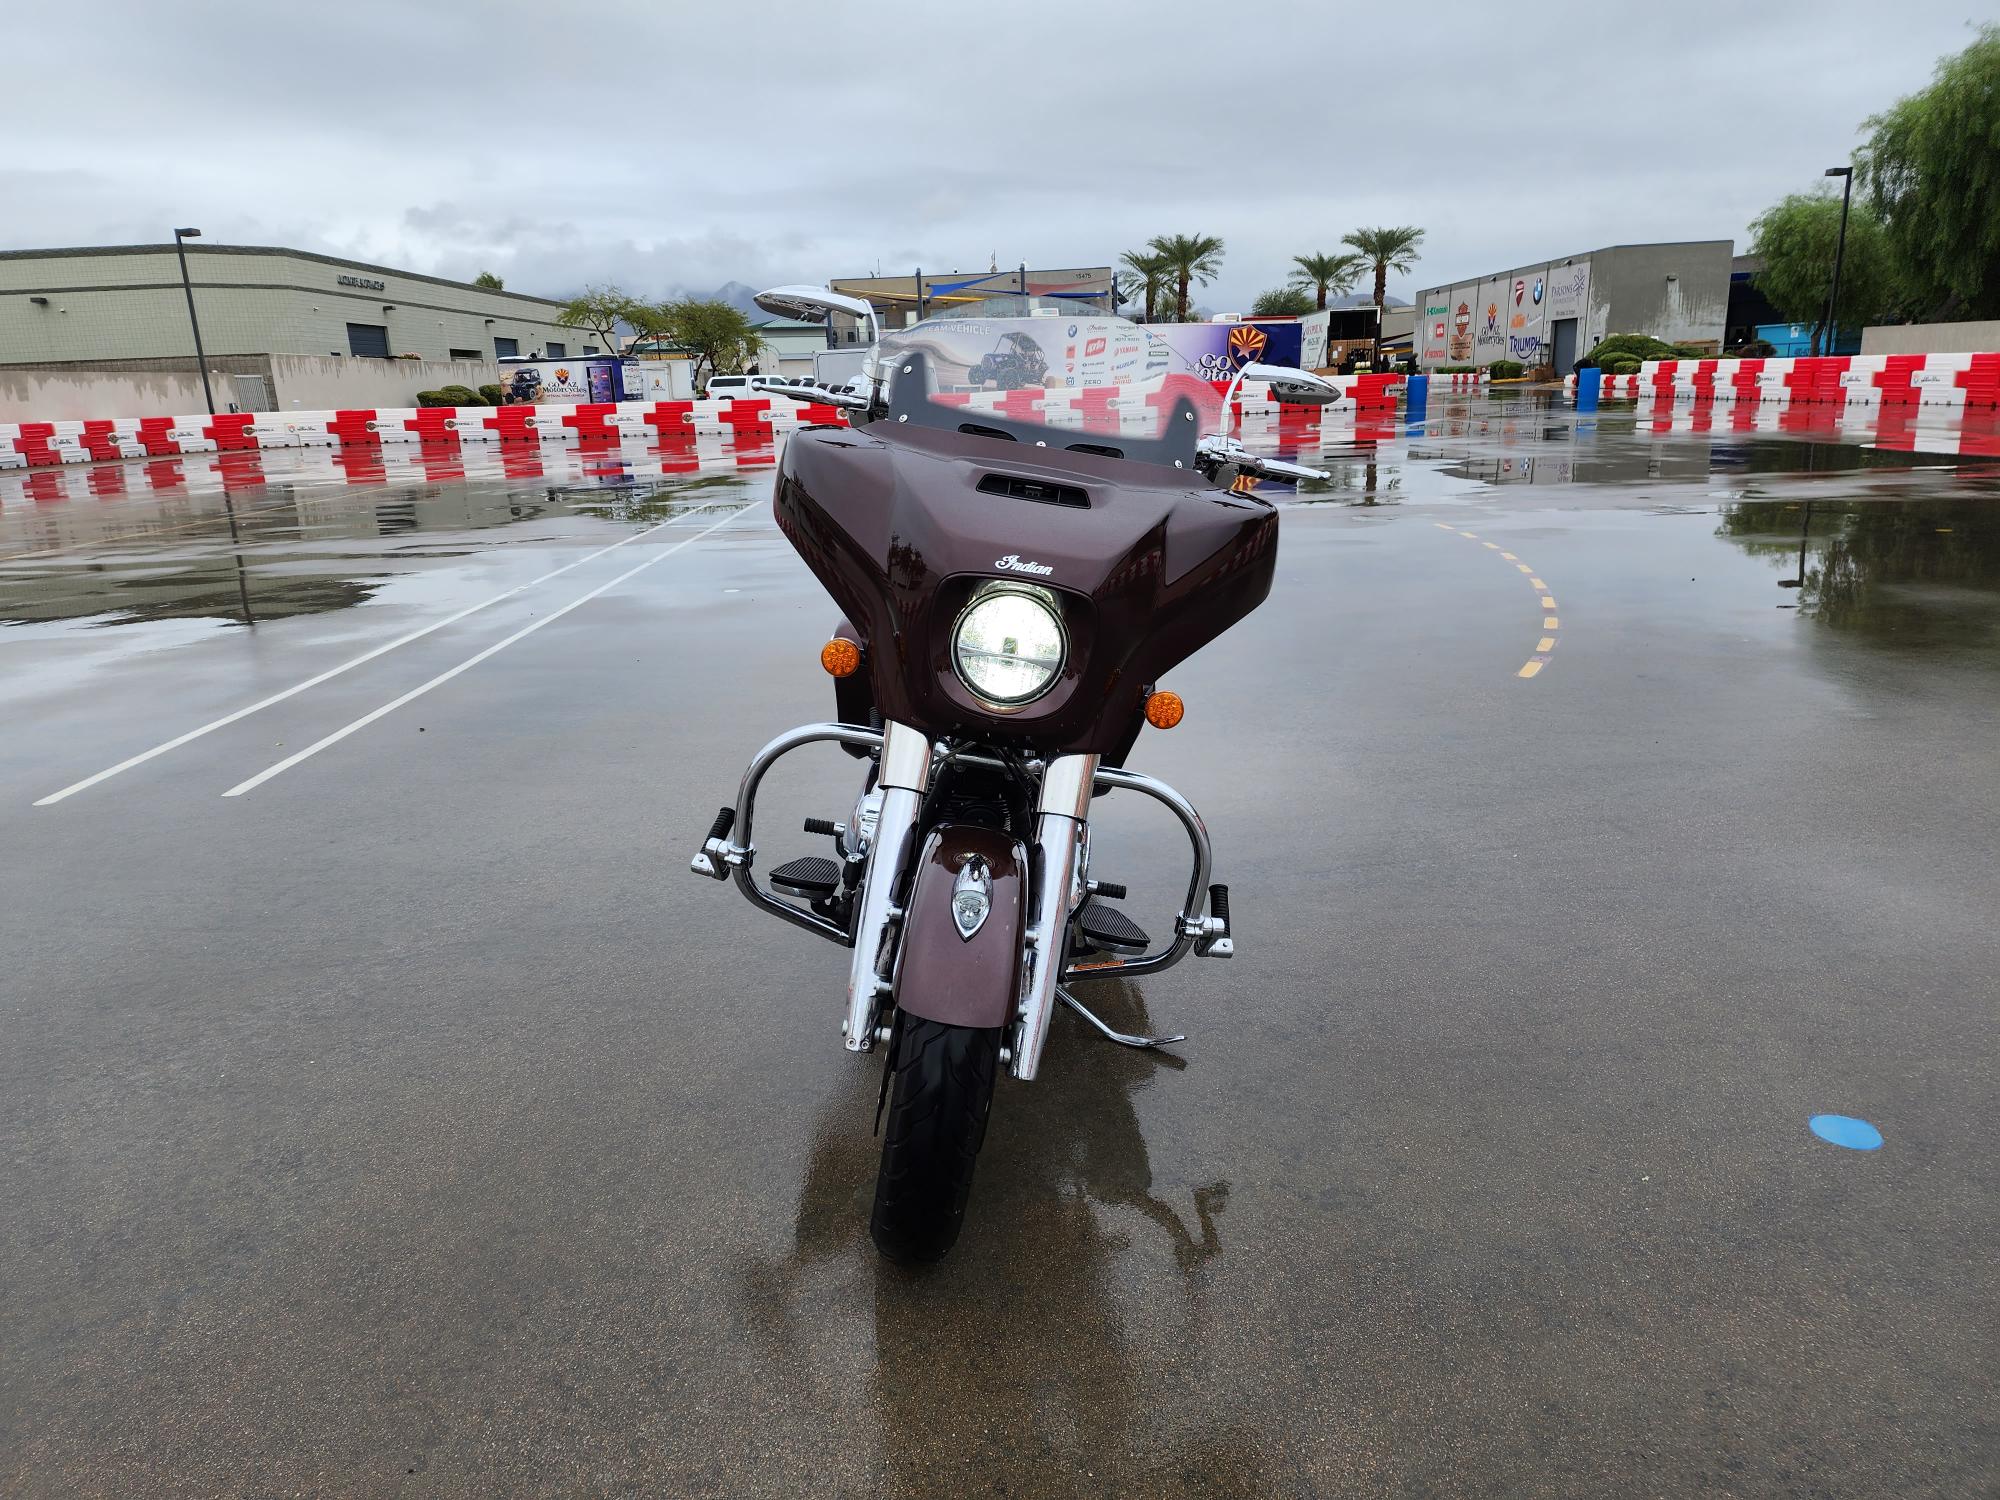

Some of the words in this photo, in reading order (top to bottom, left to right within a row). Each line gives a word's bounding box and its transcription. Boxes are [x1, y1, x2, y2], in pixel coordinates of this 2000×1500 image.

[950, 324, 991, 335] VEHICLE
[1200, 353, 1232, 370] GO
[994, 554, 1054, 576] Indian
